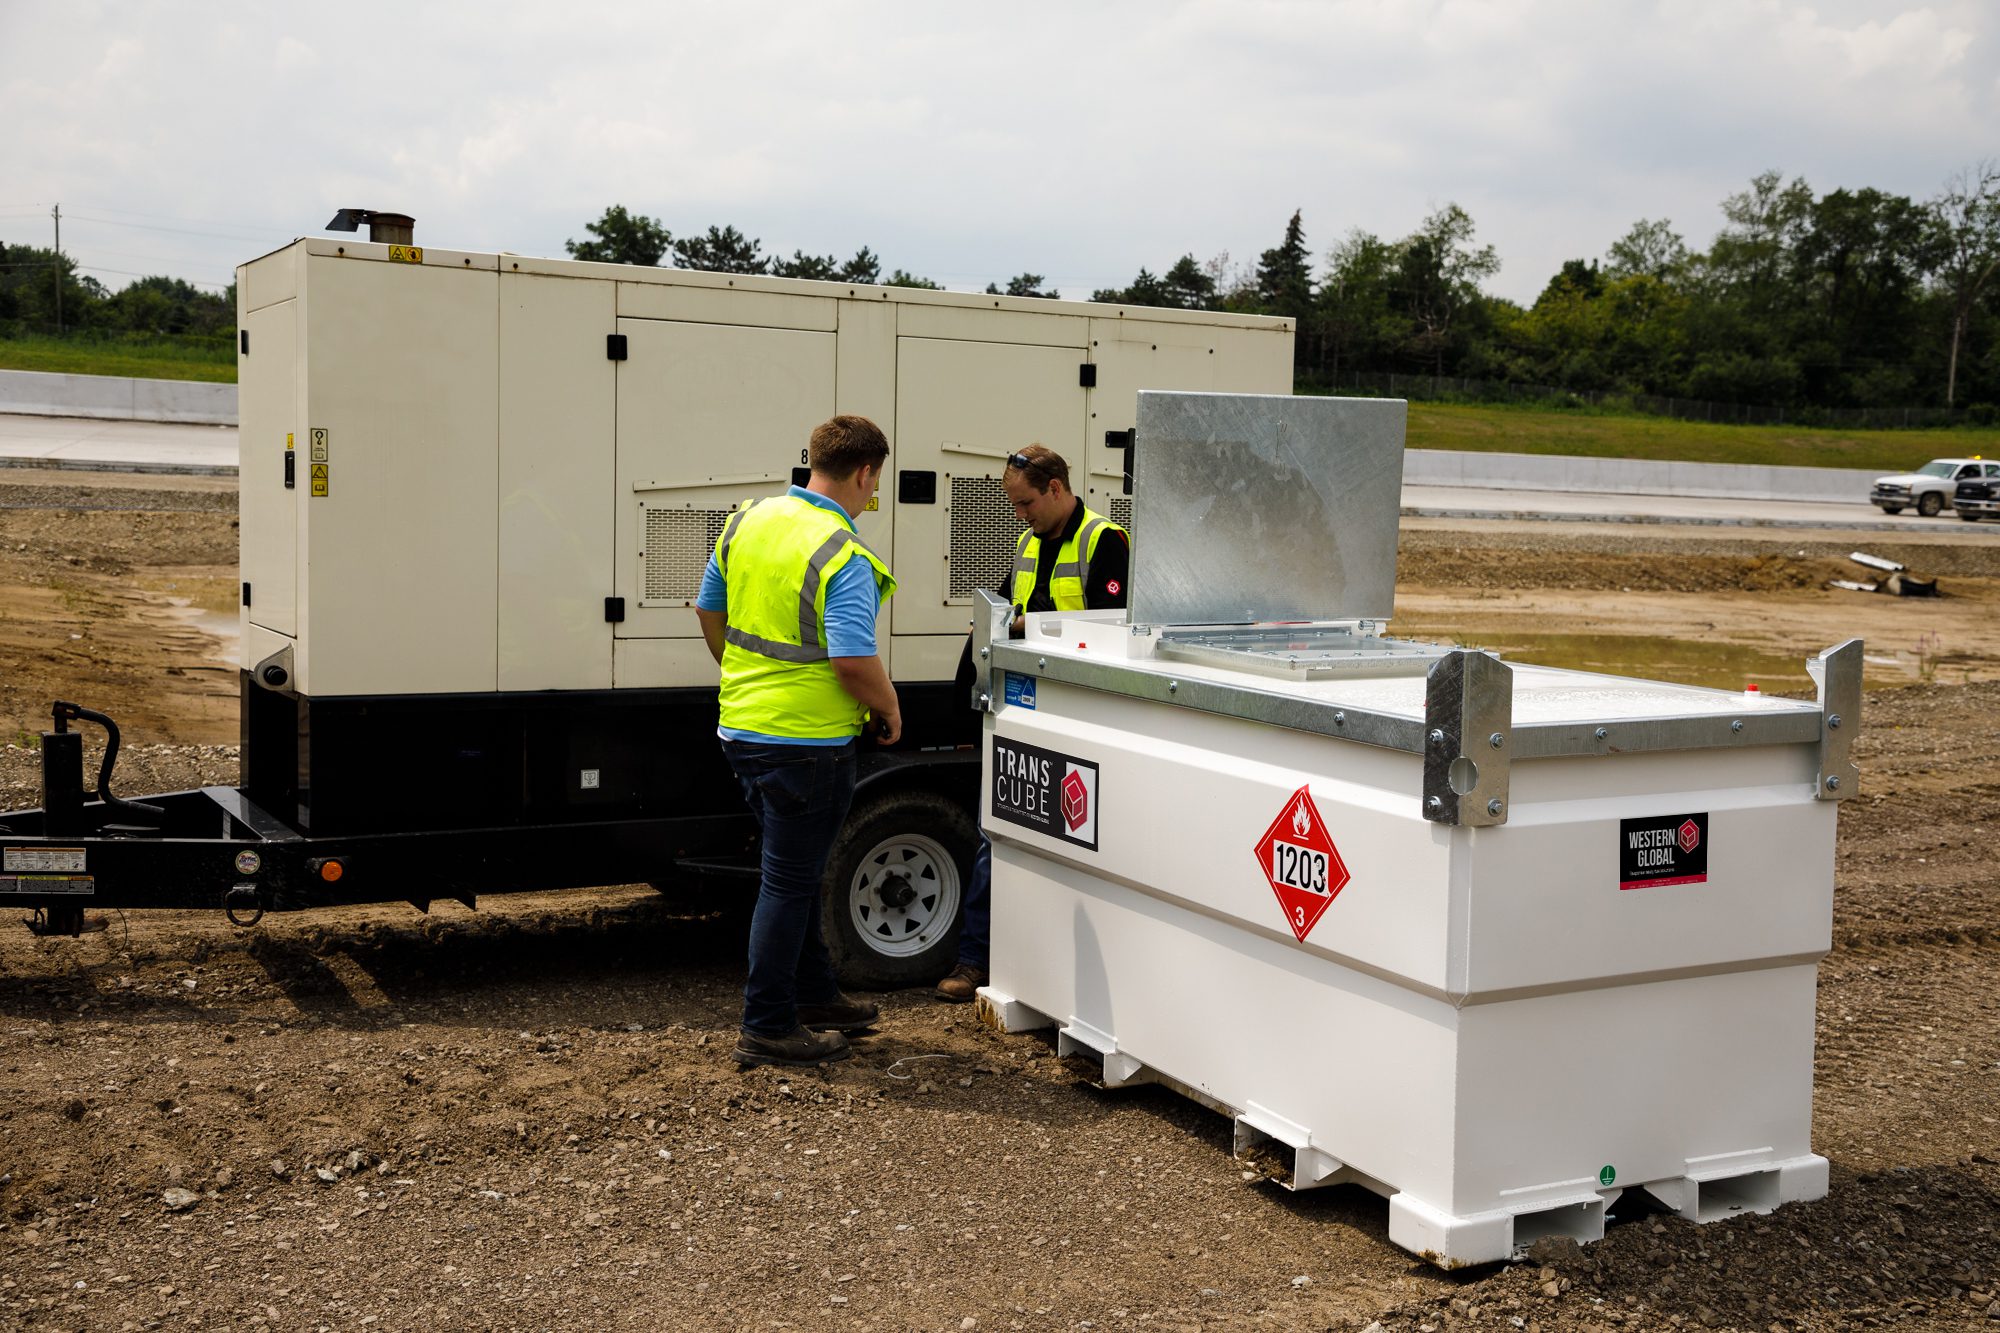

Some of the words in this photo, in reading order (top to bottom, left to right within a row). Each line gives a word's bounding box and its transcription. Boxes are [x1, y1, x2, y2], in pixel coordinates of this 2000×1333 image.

[997, 746, 1050, 787] TRANS
[996, 775, 1050, 817] CUBE
[1628, 828, 1676, 849] WESTERN
[1276, 843, 1326, 893] 1203
[1637, 847, 1675, 867] GLOBAL
[1295, 906, 1305, 927] 3
